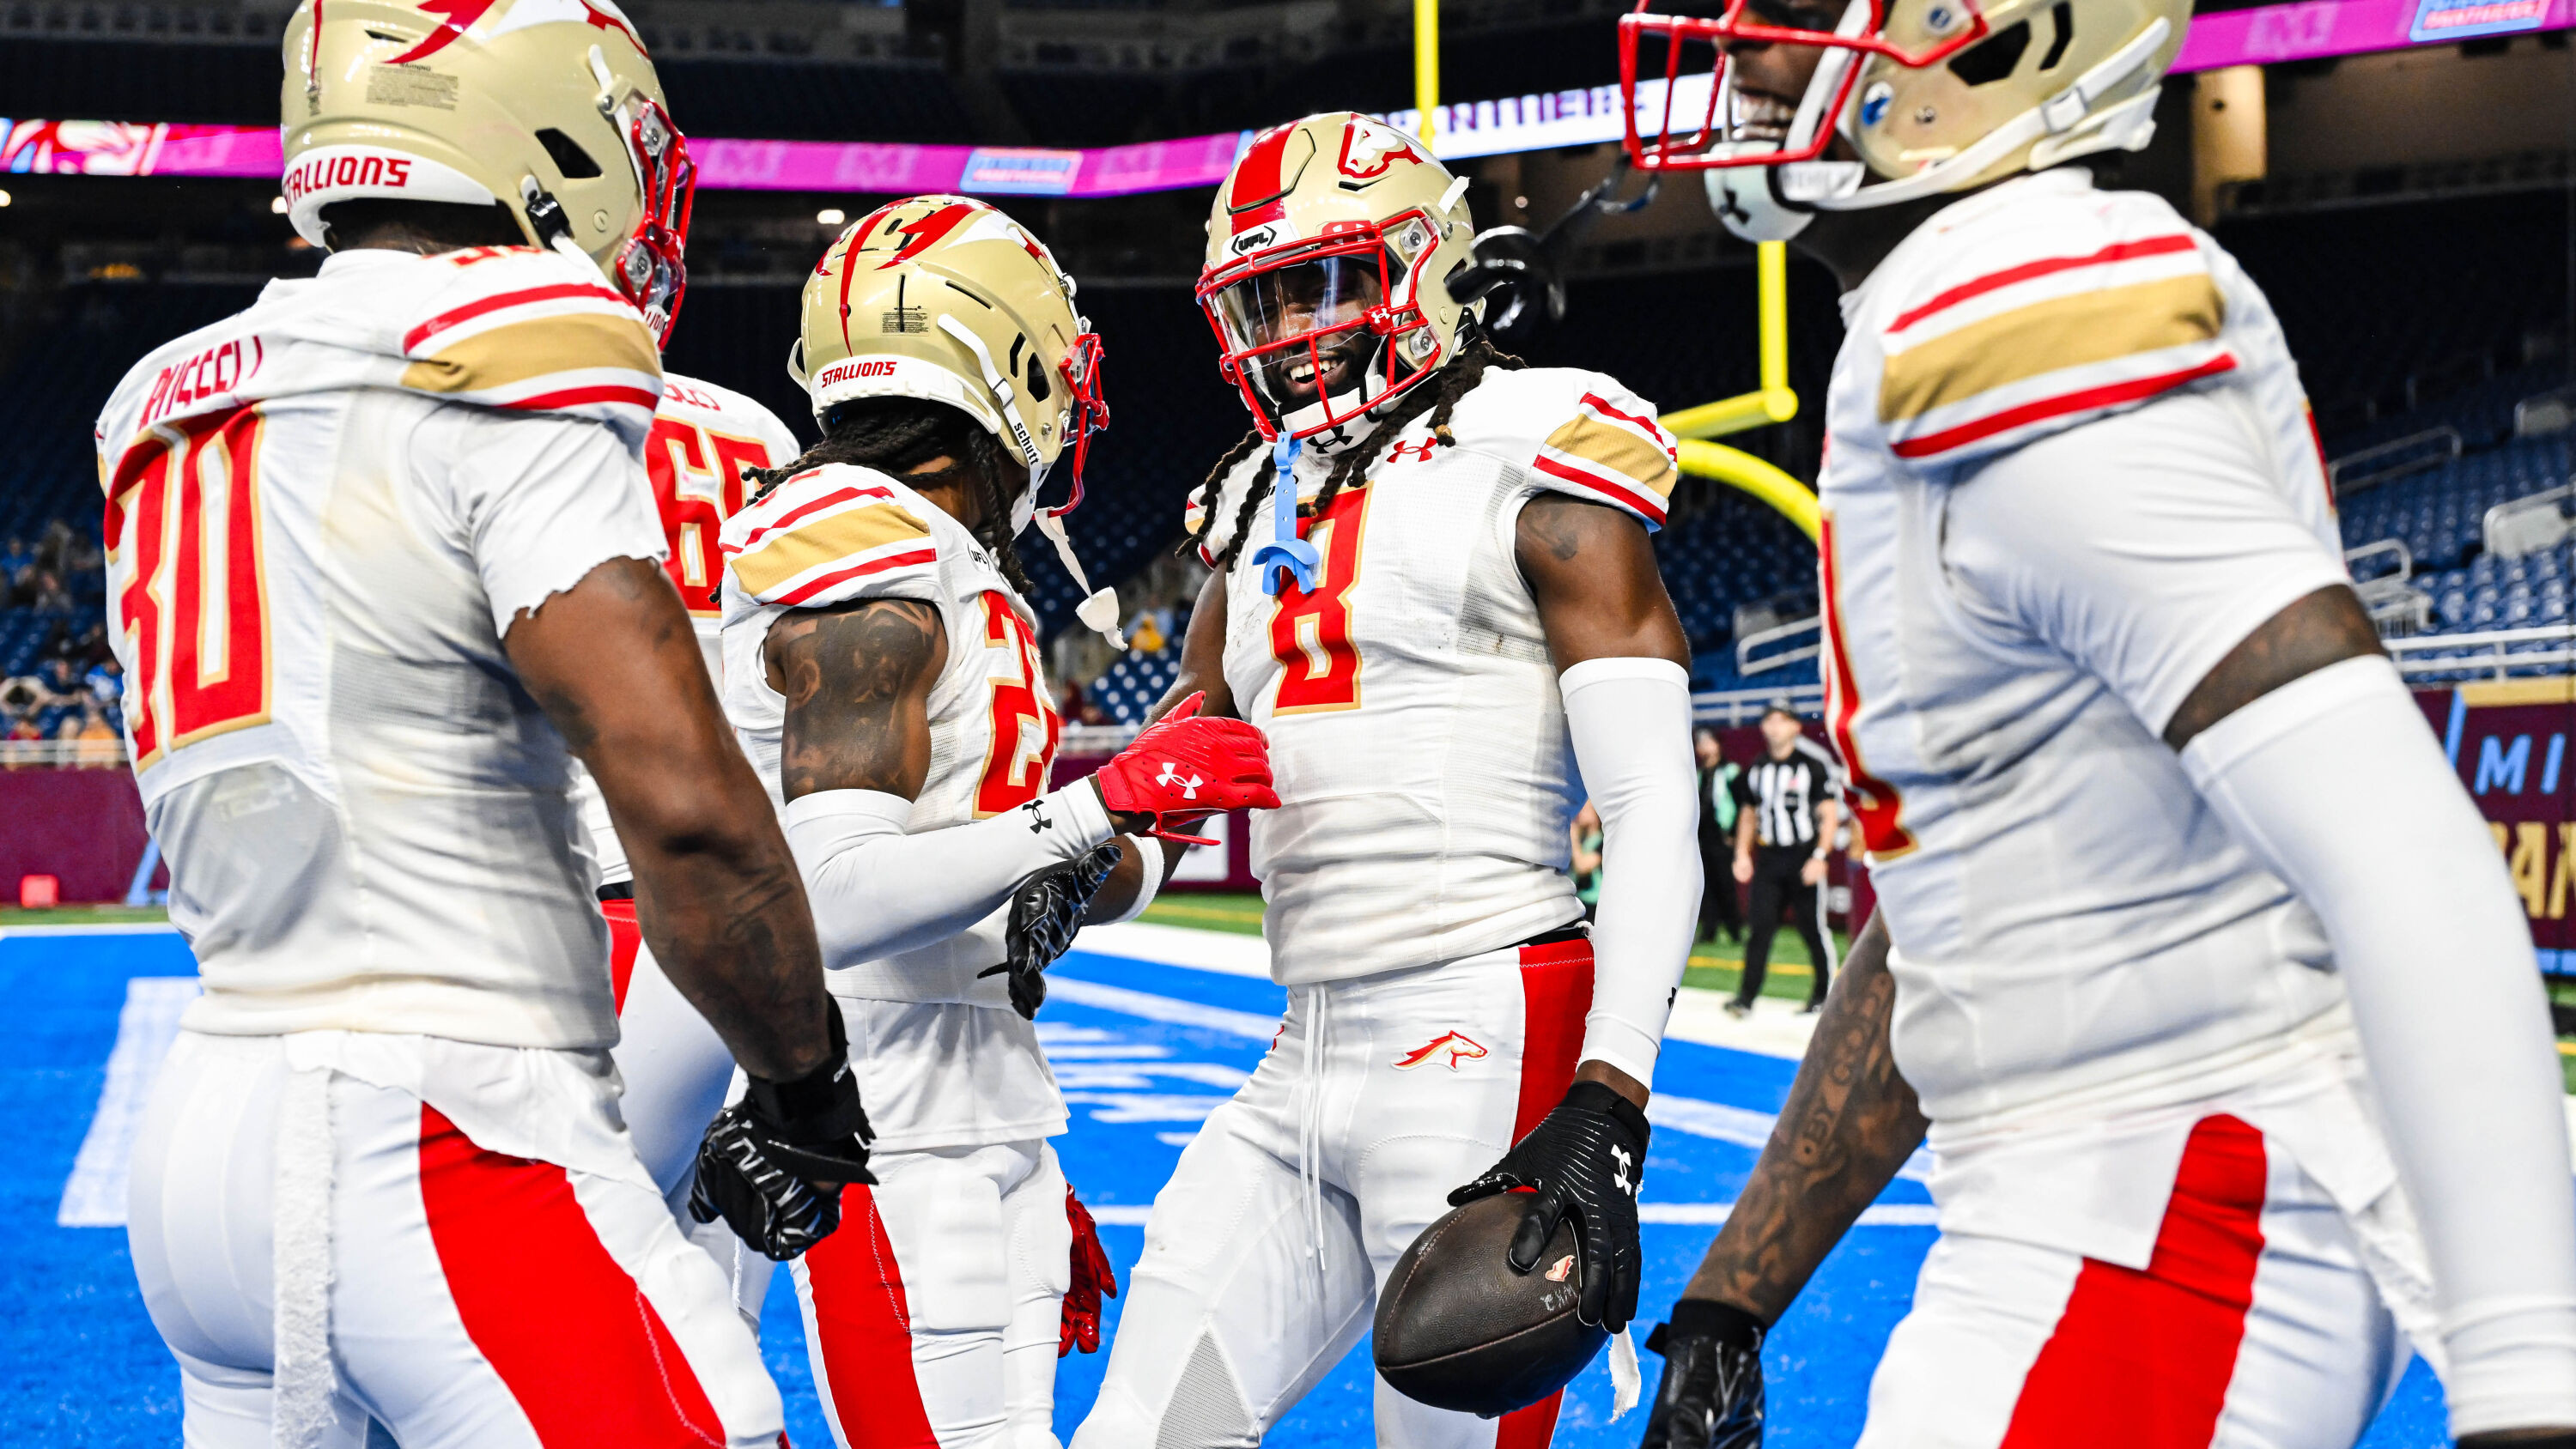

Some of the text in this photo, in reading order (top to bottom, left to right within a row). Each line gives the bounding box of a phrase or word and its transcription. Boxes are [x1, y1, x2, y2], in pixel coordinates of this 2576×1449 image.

[822, 361, 897, 388] STALLIONS
[1013, 422, 1040, 465] schutt
[103, 400, 272, 779] 30
[1267, 480, 1376, 718] 8
